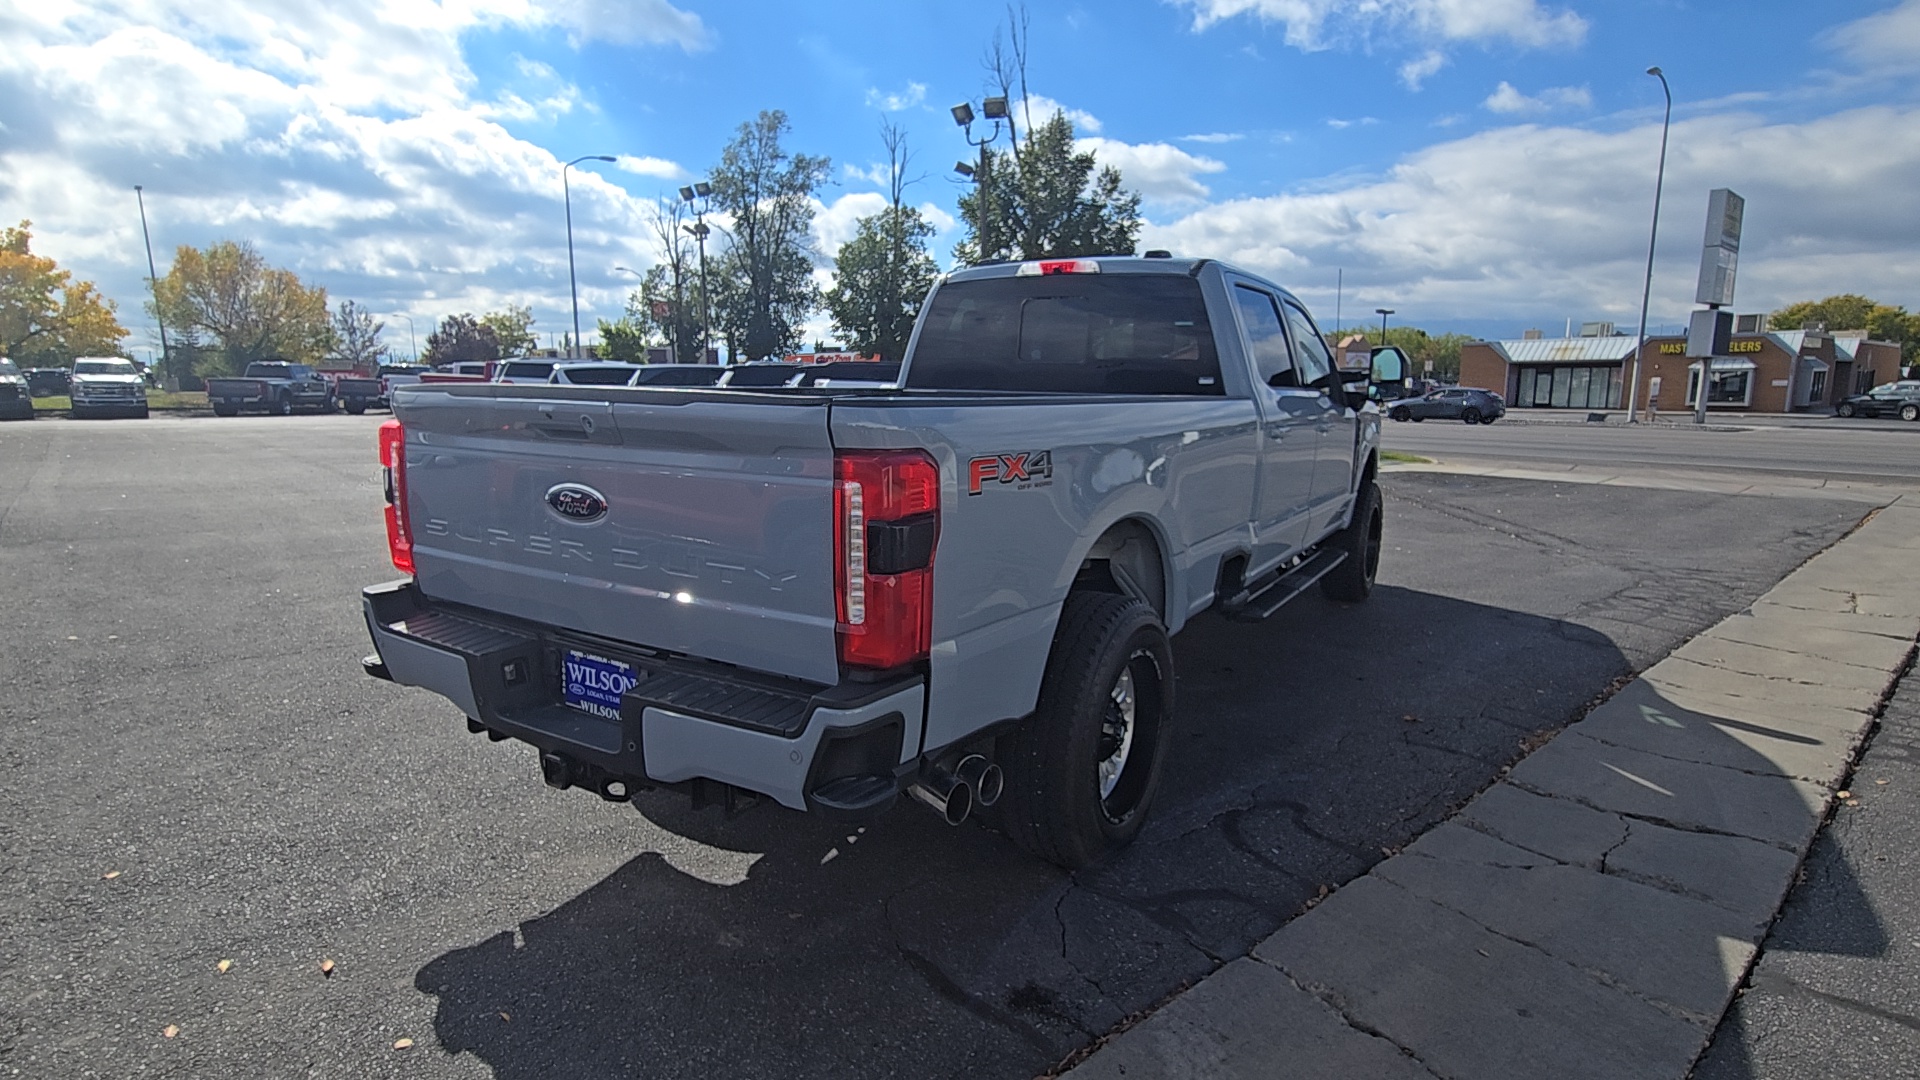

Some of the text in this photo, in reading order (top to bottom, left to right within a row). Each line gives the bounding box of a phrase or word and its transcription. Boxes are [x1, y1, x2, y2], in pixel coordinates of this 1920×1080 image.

[1660, 341, 1762, 354] MAST ELERS
[968, 450, 1053, 496] FX4
[557, 490, 592, 516] Ford
[426, 518, 798, 592] SUPER DUTY
